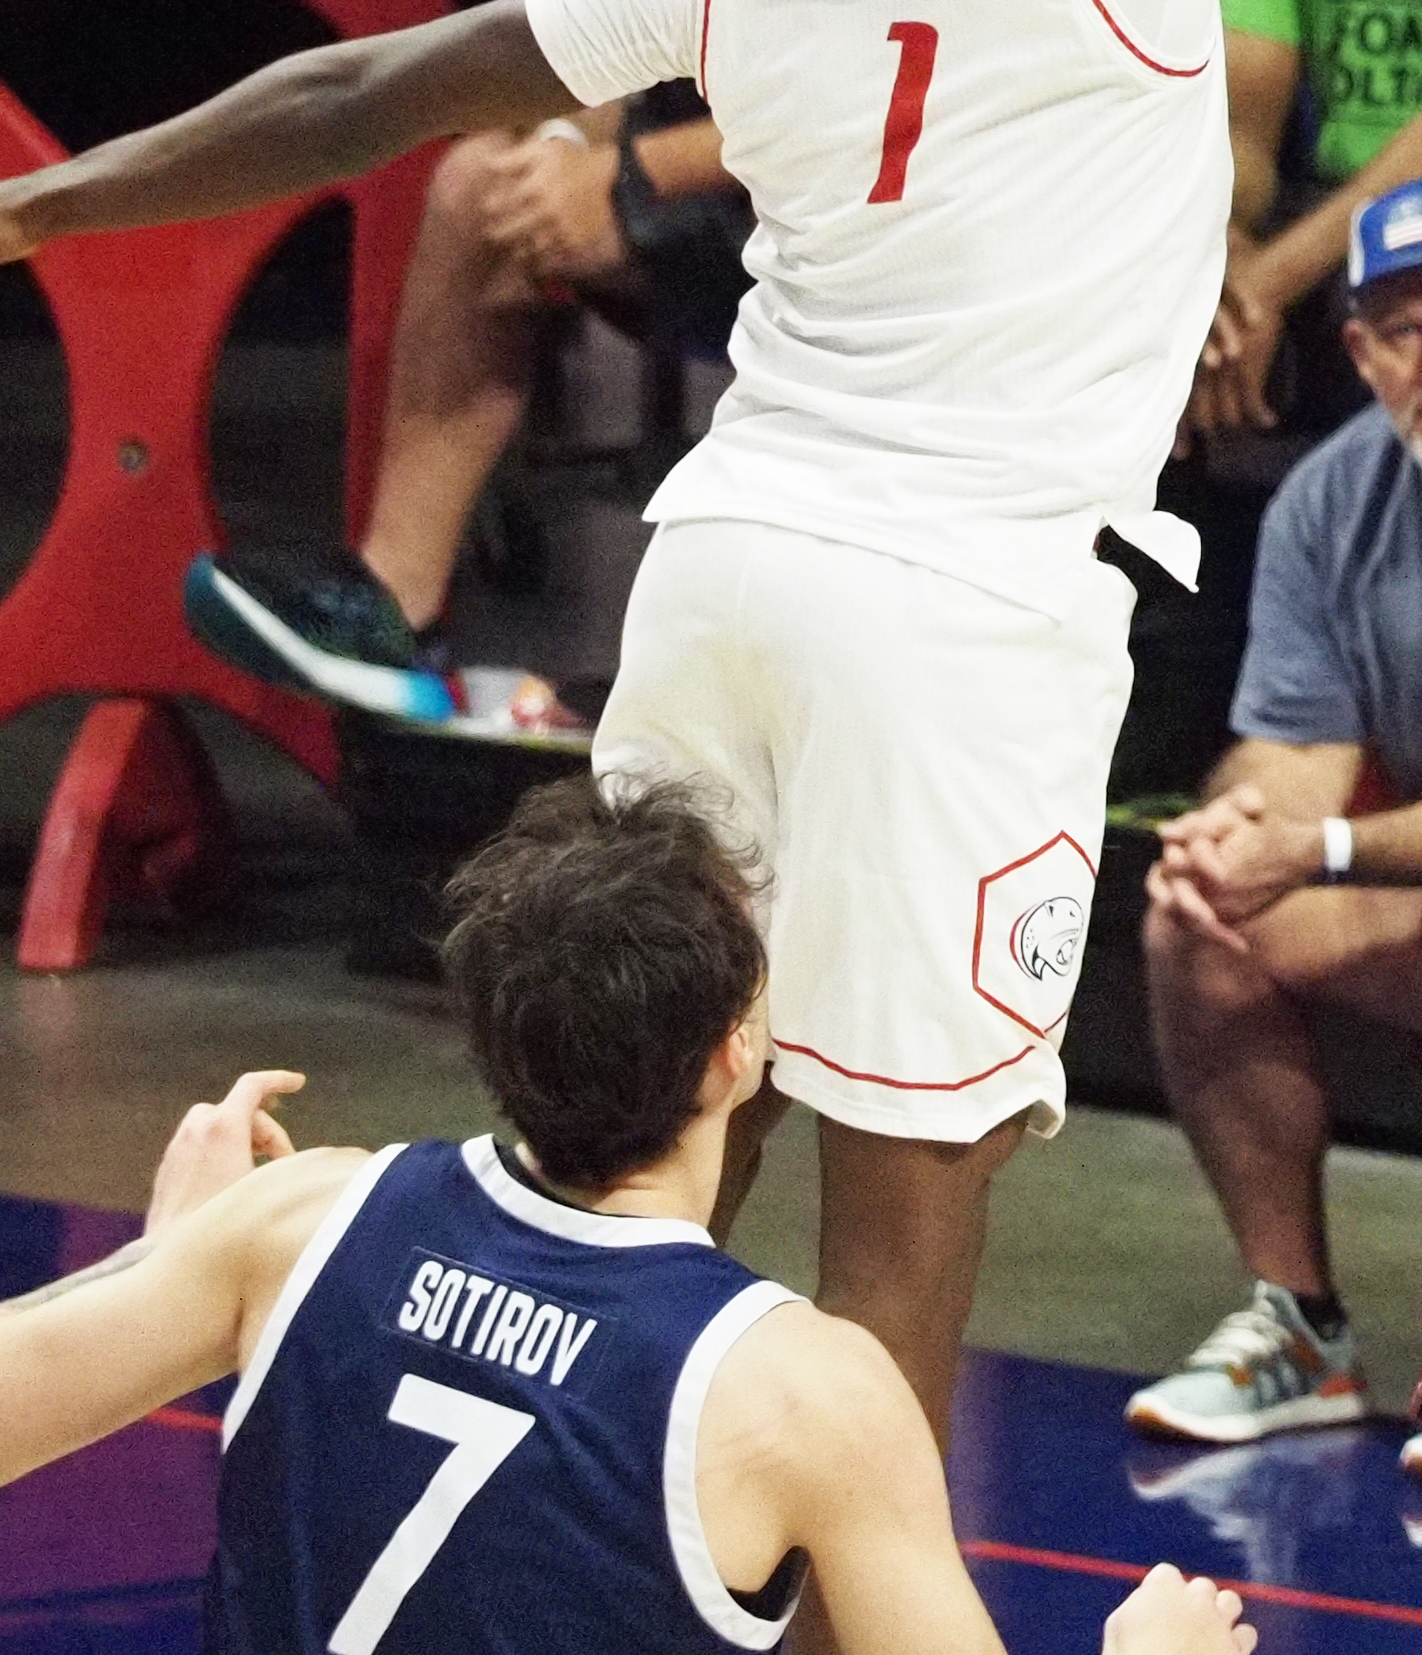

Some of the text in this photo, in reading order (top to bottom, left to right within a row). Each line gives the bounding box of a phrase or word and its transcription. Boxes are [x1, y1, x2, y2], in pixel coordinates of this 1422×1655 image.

[867, 21, 939, 204] 1
[398, 1260, 598, 1387] SOTIROV
[327, 1372, 536, 1655] 7
